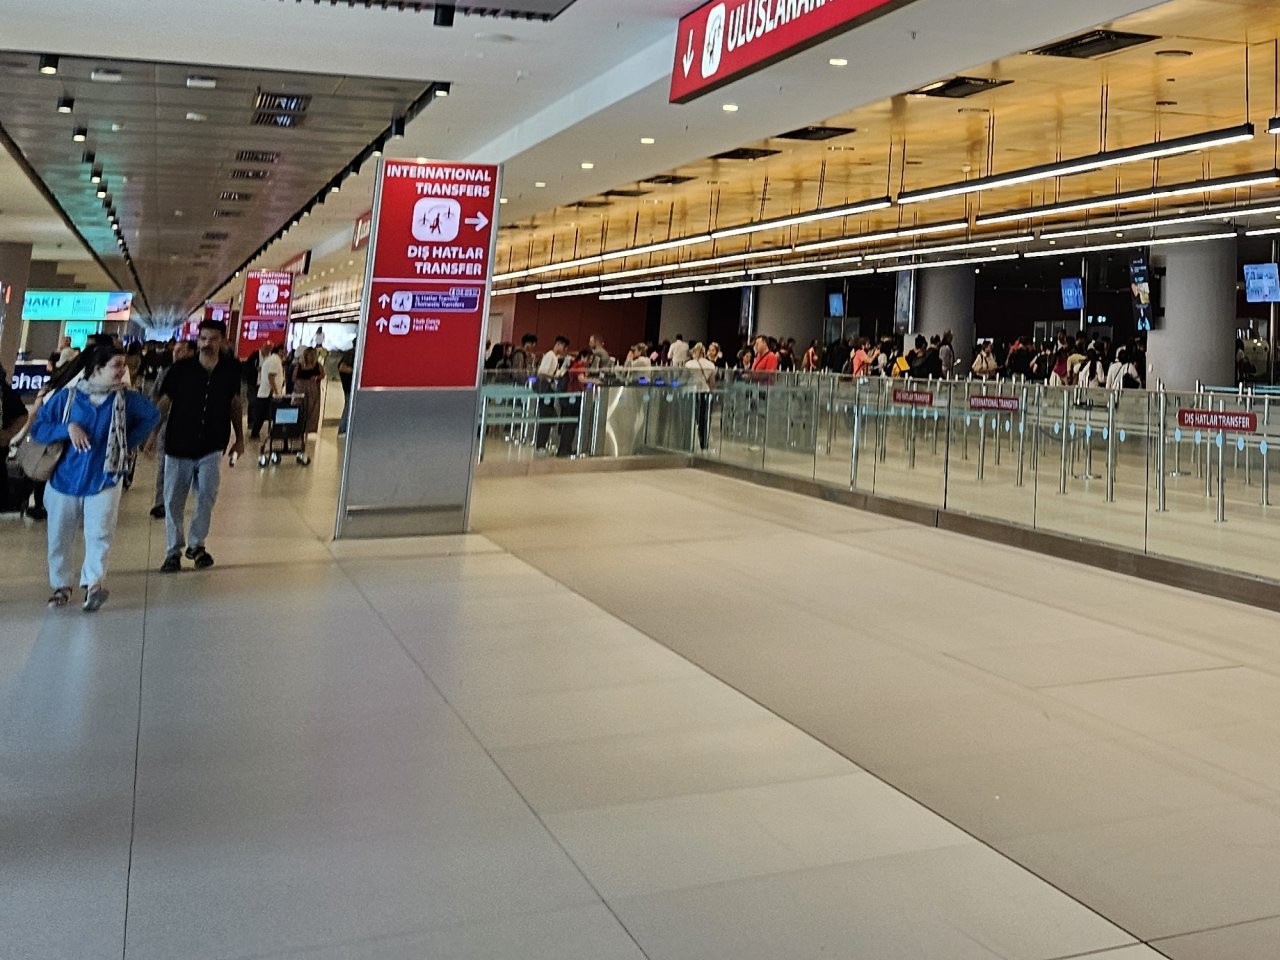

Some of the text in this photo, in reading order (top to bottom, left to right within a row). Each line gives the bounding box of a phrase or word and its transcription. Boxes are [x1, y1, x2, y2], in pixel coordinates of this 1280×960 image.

[387, 165, 491, 182] INTERNATIONAL
[415, 182, 490, 197] TRANSFERS
[432, 246, 484, 260] HATLAR
[414, 261, 482, 275] TRANSFER
[1195, 413, 1218, 426] HATLAR
[1218, 415, 1250, 428] TRANSFER
